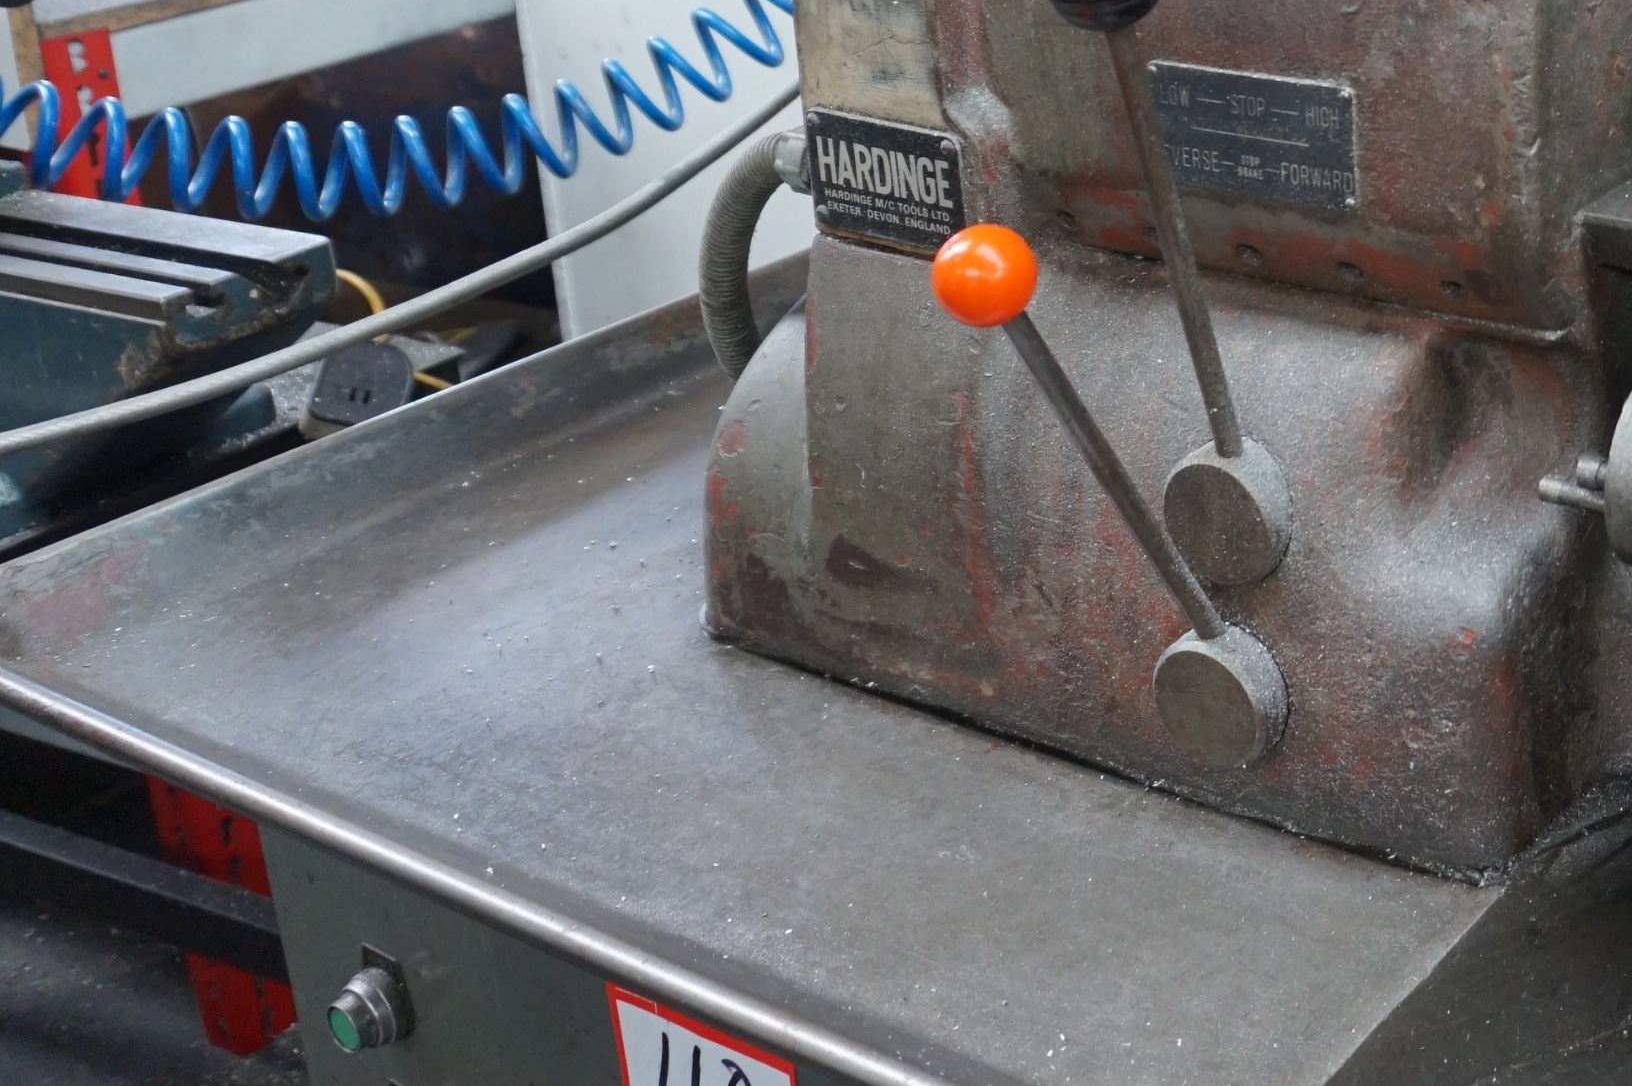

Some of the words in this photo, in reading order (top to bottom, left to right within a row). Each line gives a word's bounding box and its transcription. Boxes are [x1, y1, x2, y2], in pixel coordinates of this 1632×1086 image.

[1159, 83, 1190, 108] LOW
[1230, 94, 1266, 117] STOP
[1305, 104, 1340, 129] HIGH
[815, 135, 954, 208] HARDINGE
[1164, 143, 1221, 173] VERSE
[1280, 162, 1354, 193] FORWARD
[824, 187, 872, 206] HARDINGE
[875, 197, 895, 210] M/C
[898, 202, 929, 217] TOOLS
[931, 211, 950, 222] LTD
[904, 217, 951, 235] ENGLAND
